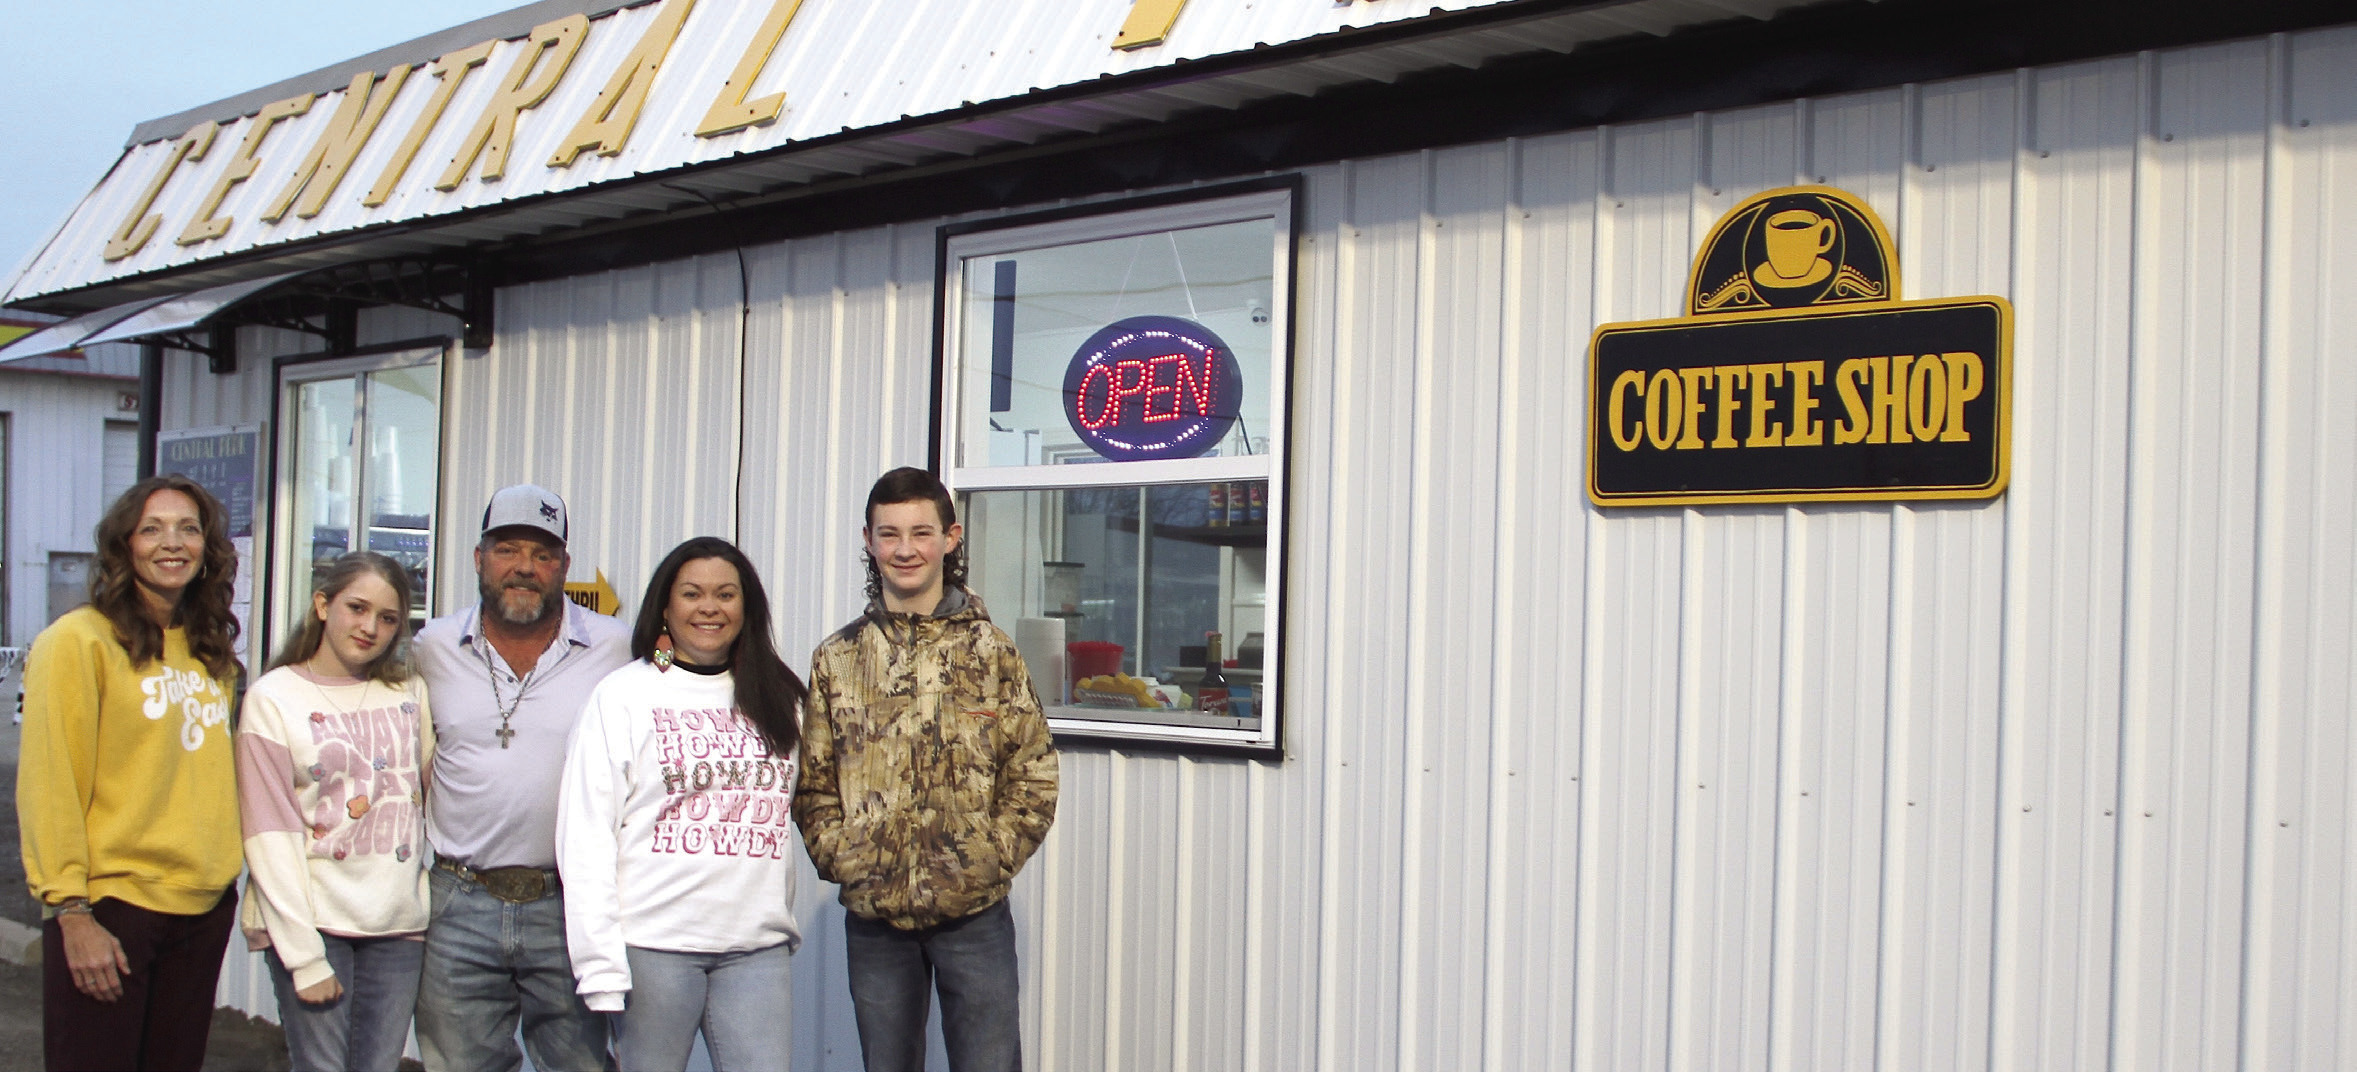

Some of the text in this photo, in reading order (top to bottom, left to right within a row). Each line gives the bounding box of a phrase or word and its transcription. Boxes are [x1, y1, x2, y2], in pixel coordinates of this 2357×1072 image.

[103, 0, 804, 262] CENTRAL
[1077, 348, 1214, 430] OPEN
[1608, 351, 1984, 452] COFFEE SHOP
[141, 666, 206, 720] Take
[652, 707, 757, 733] HOW
[656, 733, 790, 764] HOWD
[661, 760, 794, 794] HOWDY
[655, 791, 792, 828] HOWDY
[651, 822, 789, 860] HOWDY
